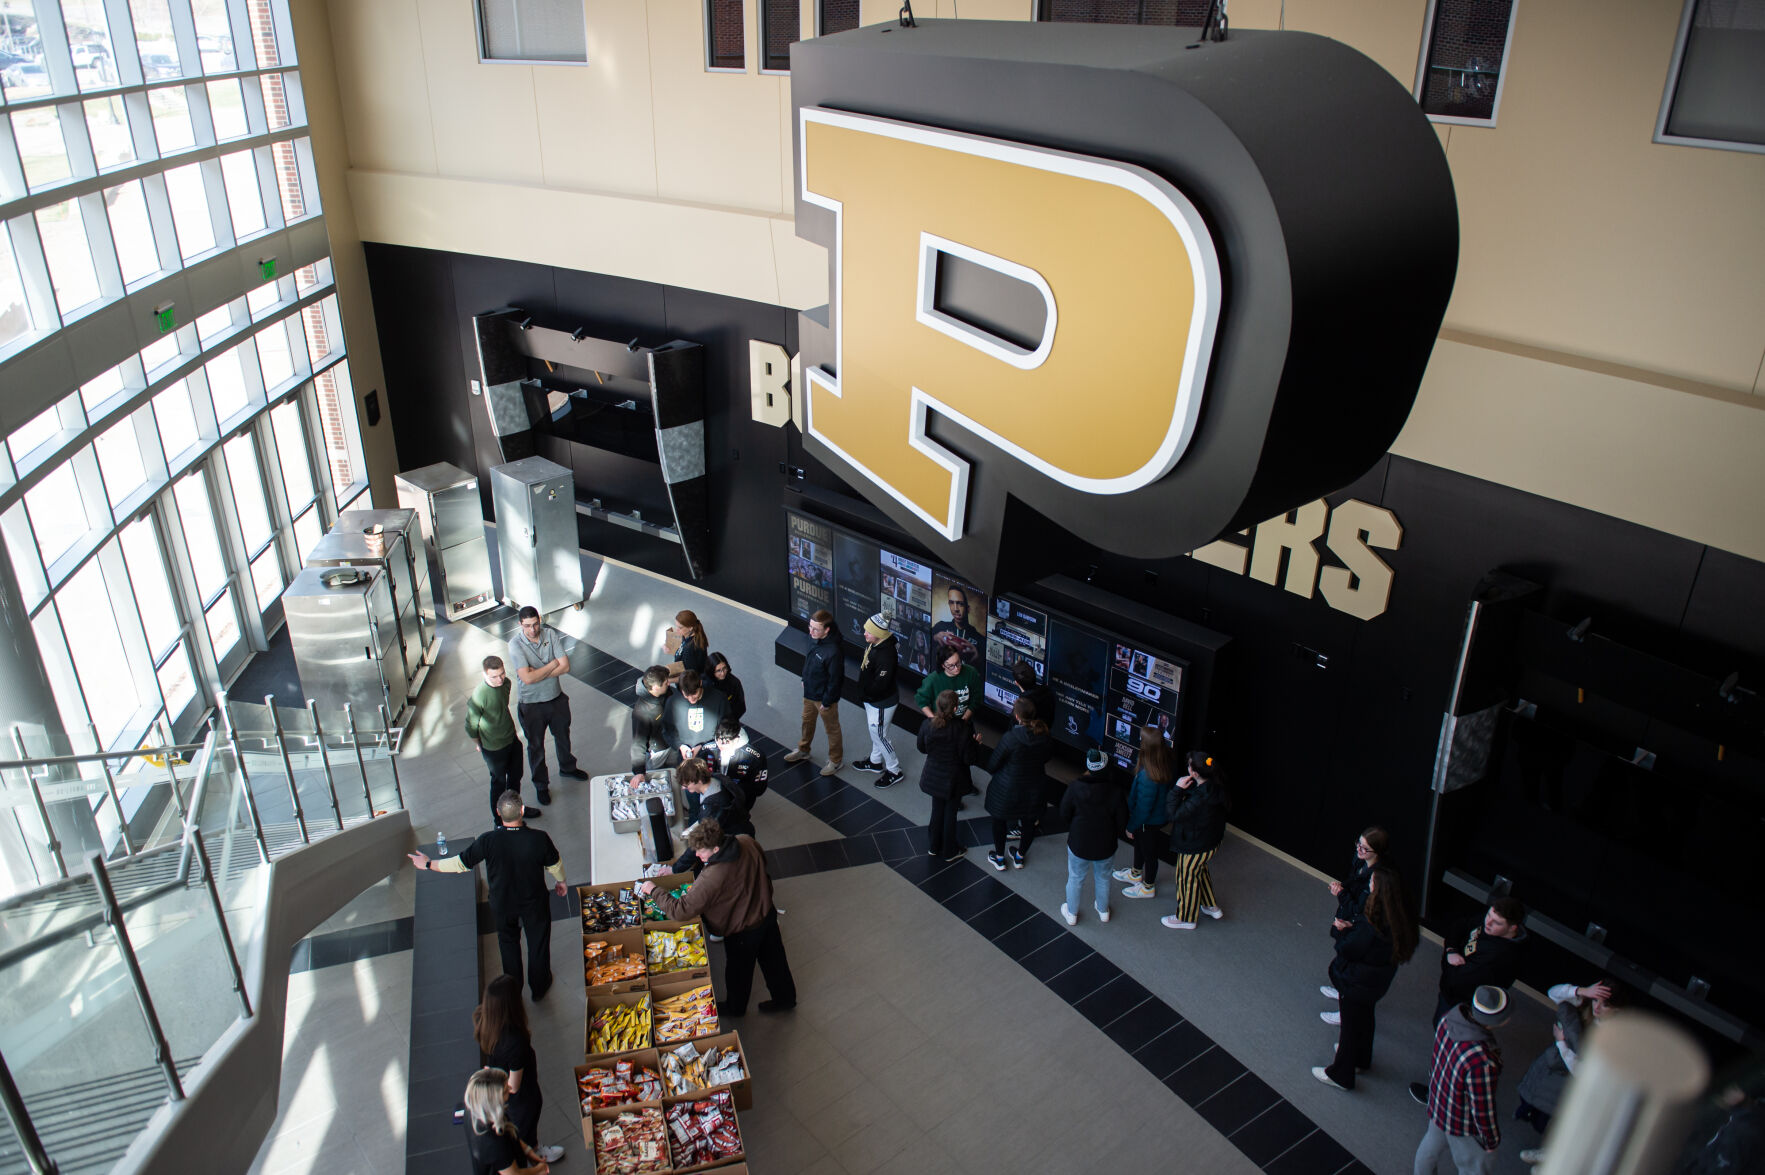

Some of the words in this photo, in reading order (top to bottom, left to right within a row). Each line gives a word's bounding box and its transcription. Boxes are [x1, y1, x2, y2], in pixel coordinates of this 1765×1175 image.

[799, 106, 1224, 541] P
[749, 339, 802, 434] B
[794, 577, 829, 603] PURDUE
[1127, 678, 1161, 701] 90
